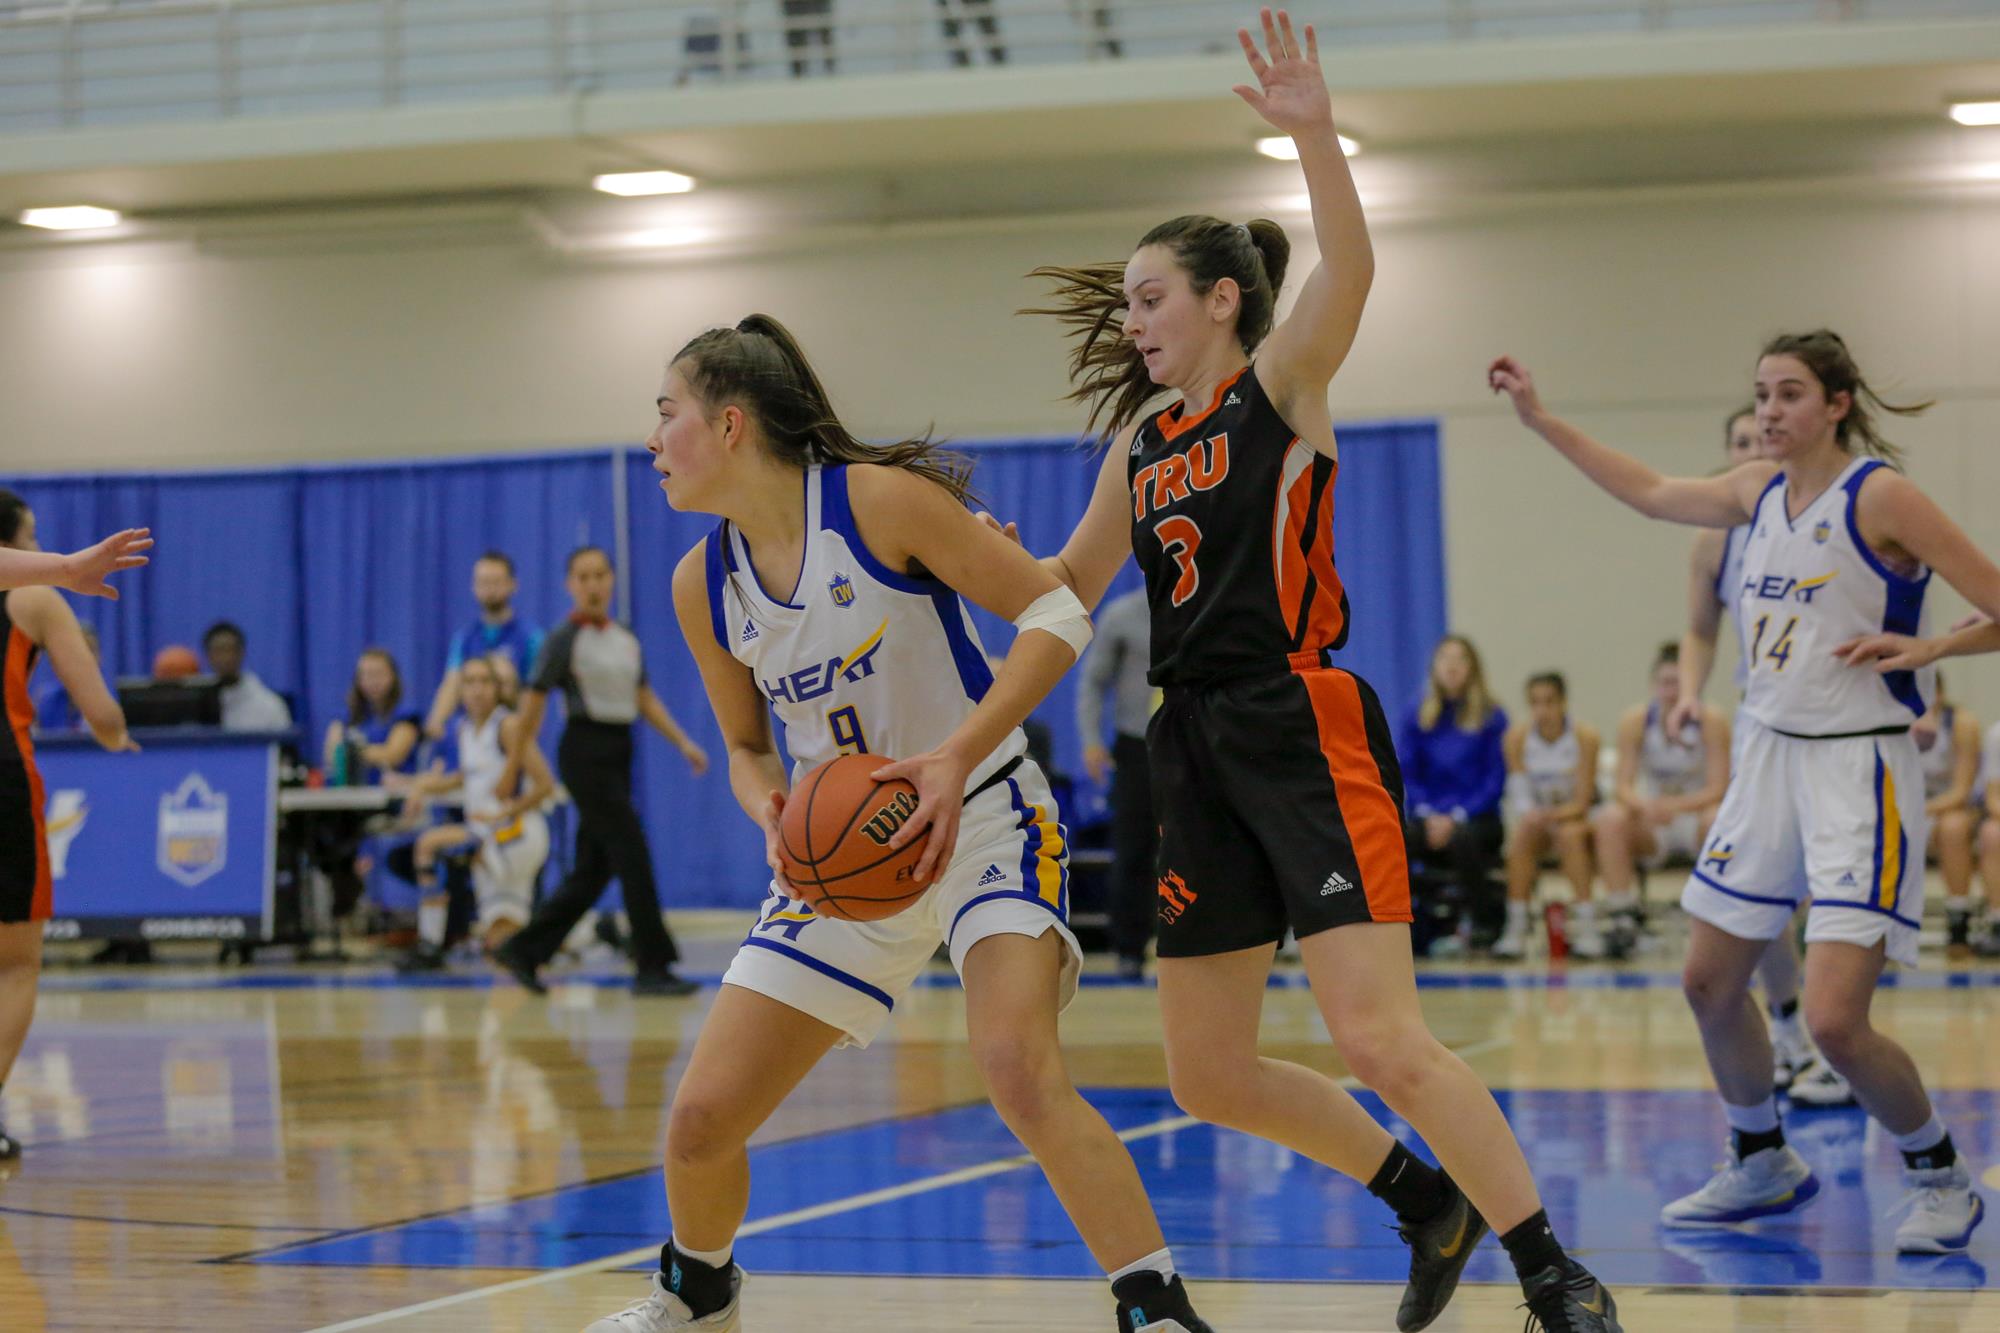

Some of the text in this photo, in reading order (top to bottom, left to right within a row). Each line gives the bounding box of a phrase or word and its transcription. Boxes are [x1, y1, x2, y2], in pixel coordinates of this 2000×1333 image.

[1133, 432, 1229, 522] TRU
[1153, 514, 1203, 608] 3
[1740, 569, 1839, 603] HEAT
[761, 617, 889, 704] HEAT
[1751, 613, 1799, 672] 14
[827, 704, 871, 756] 9
[978, 873, 1007, 887] adidas
[1320, 882, 1354, 896] adidas
